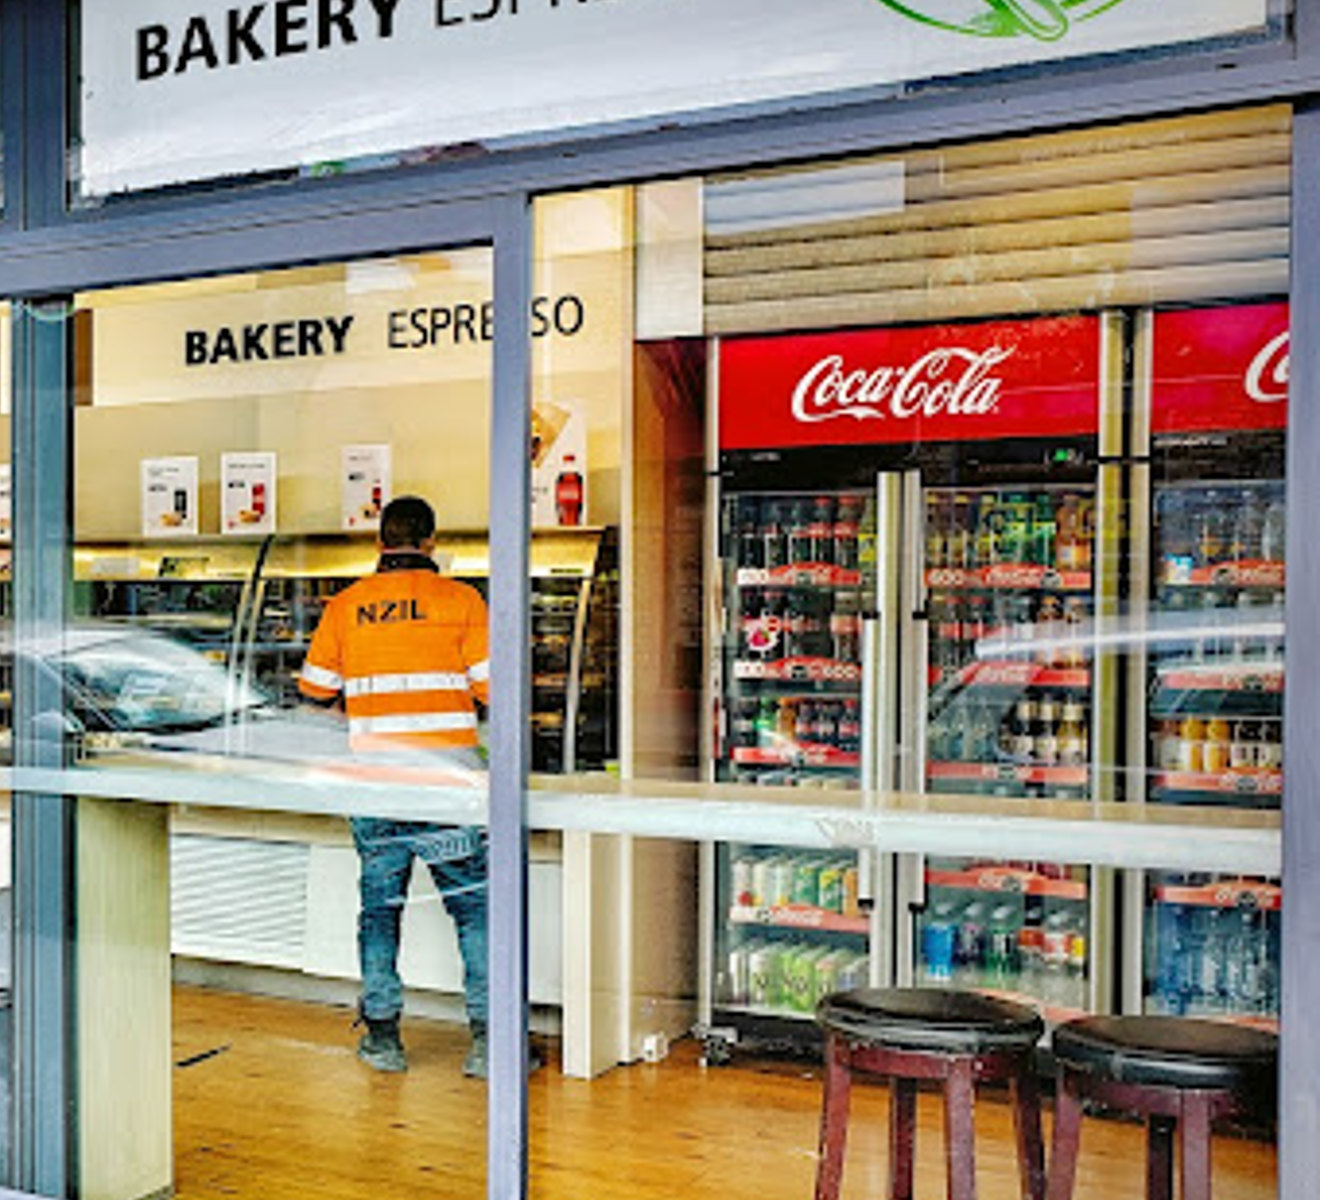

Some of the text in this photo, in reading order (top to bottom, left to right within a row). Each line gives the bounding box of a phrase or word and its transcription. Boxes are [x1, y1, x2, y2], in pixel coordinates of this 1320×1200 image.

[136, 0, 398, 81] BAKERY
[185, 296, 581, 366] BAKERY ESPRESO
[791, 344, 1018, 422] Coca-Cola
[357, 599, 427, 626] NZIL
